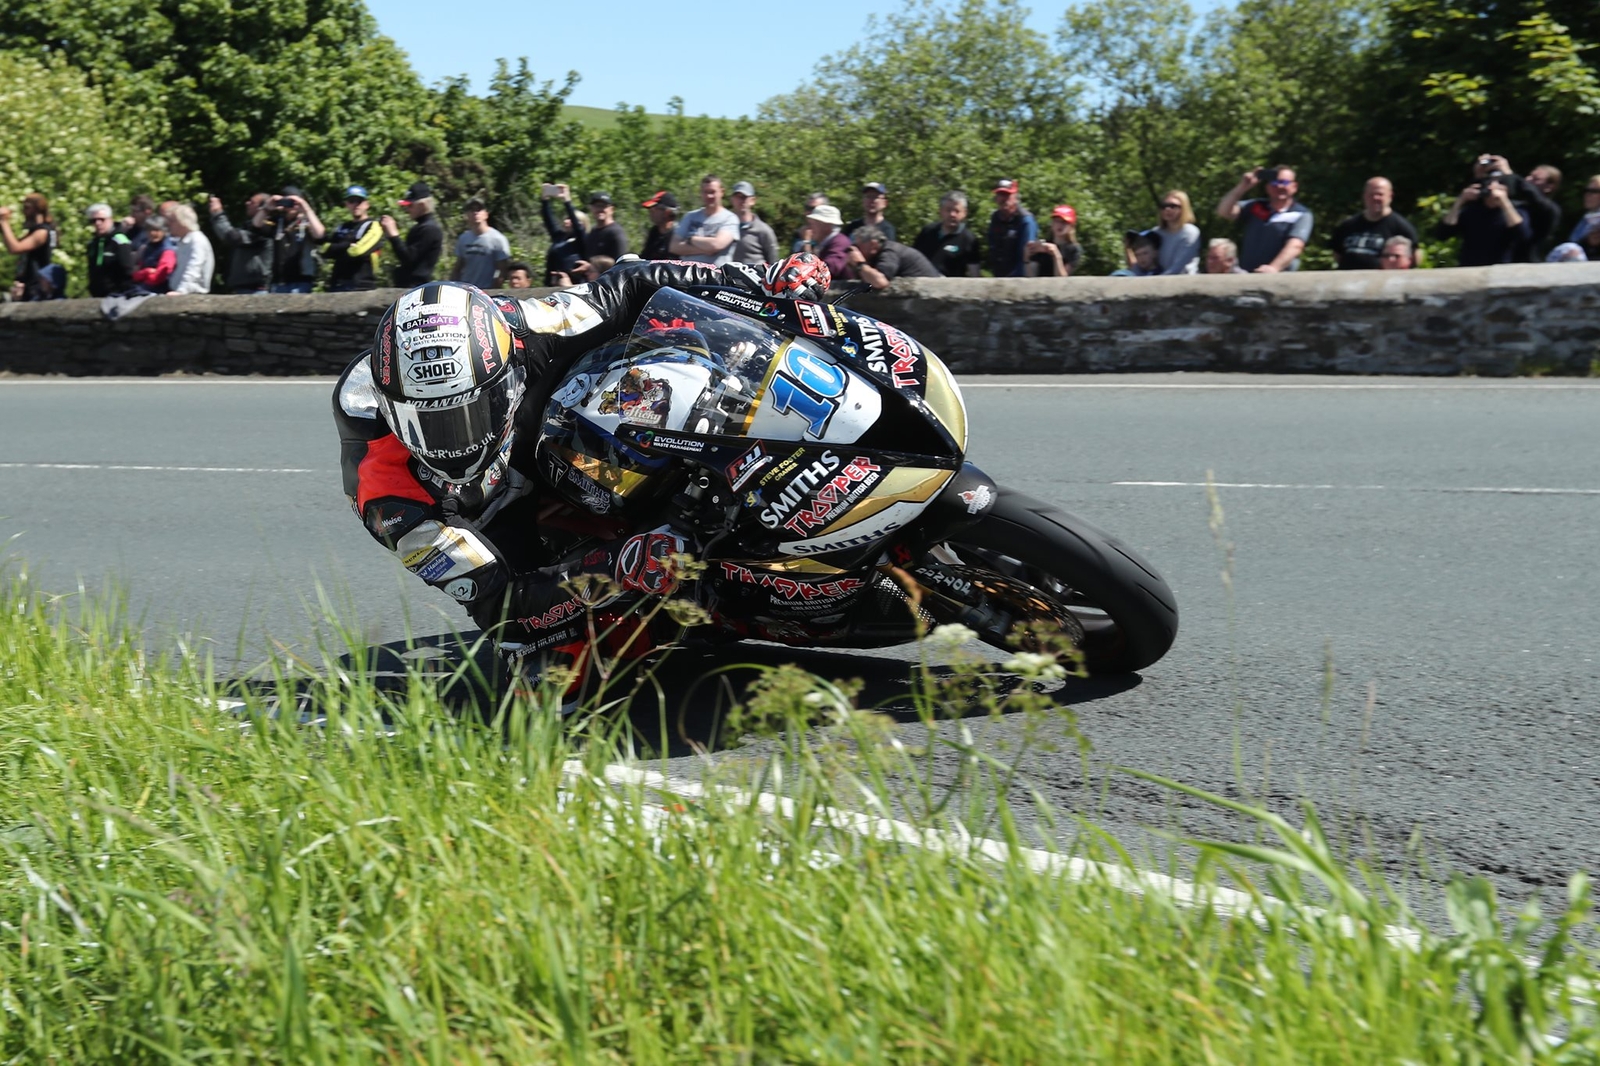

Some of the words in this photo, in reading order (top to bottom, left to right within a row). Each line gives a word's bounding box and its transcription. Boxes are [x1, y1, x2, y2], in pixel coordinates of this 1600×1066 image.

[715, 293, 762, 312] EVOLUTION
[406, 316, 454, 329] BATHGATE
[413, 332, 466, 342] EVOLUTION
[472, 304, 496, 374] TROOPER
[858, 315, 888, 374] SMITHS
[413, 362, 456, 379] SHOEI
[405, 398, 450, 409] NOLAN
[451, 387, 481, 405] OILS
[769, 344, 849, 440] 10
[654, 436, 705, 447] EVOLUTION
[759, 467, 781, 487] STEVE
[778, 447, 806, 470] FOSTER
[568, 468, 611, 503] SMITHS
[760, 450, 841, 529] SMITHS
[784, 456, 881, 538] TROOPER
[826, 500, 850, 521] PREMIUM
[848, 484, 867, 504] BRITISH
[864, 472, 881, 488] BEER
[793, 521, 901, 554] SMITHS
